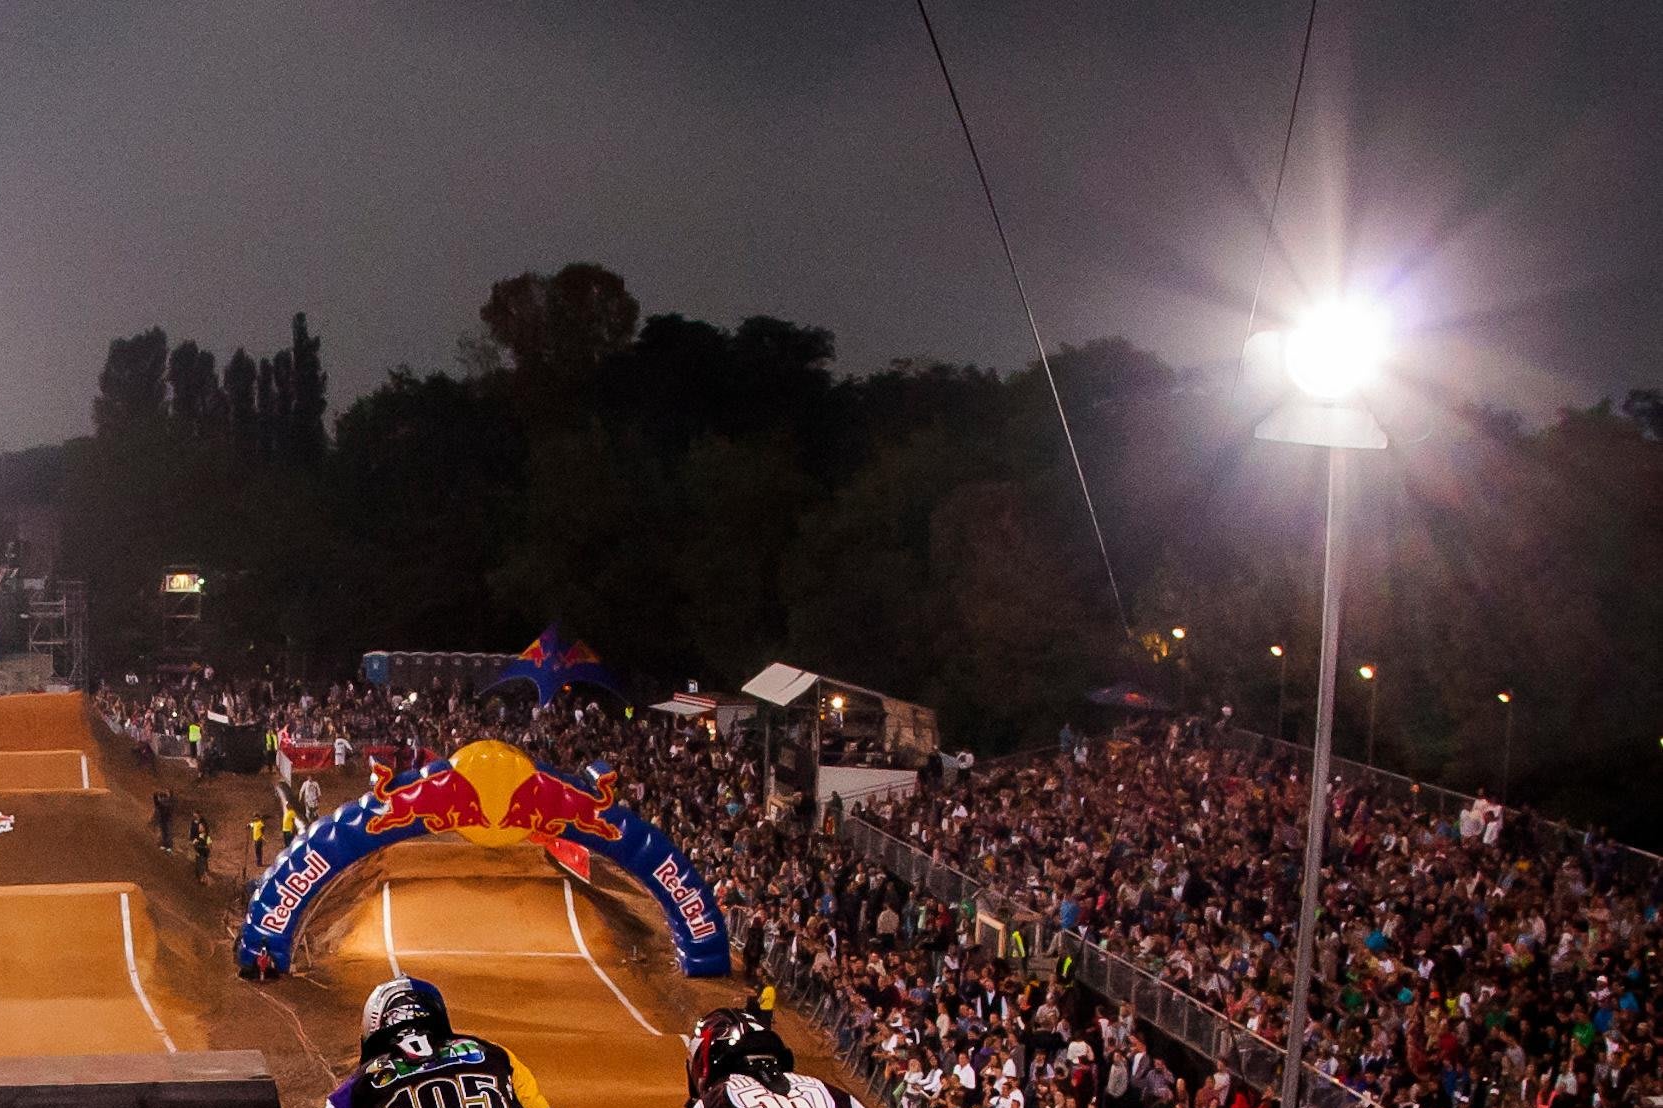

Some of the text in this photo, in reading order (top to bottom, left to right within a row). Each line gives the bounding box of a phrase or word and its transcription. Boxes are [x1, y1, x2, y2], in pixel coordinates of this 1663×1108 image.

[262, 852, 328, 932] Red Bull
[655, 861, 714, 937] Red Bull
